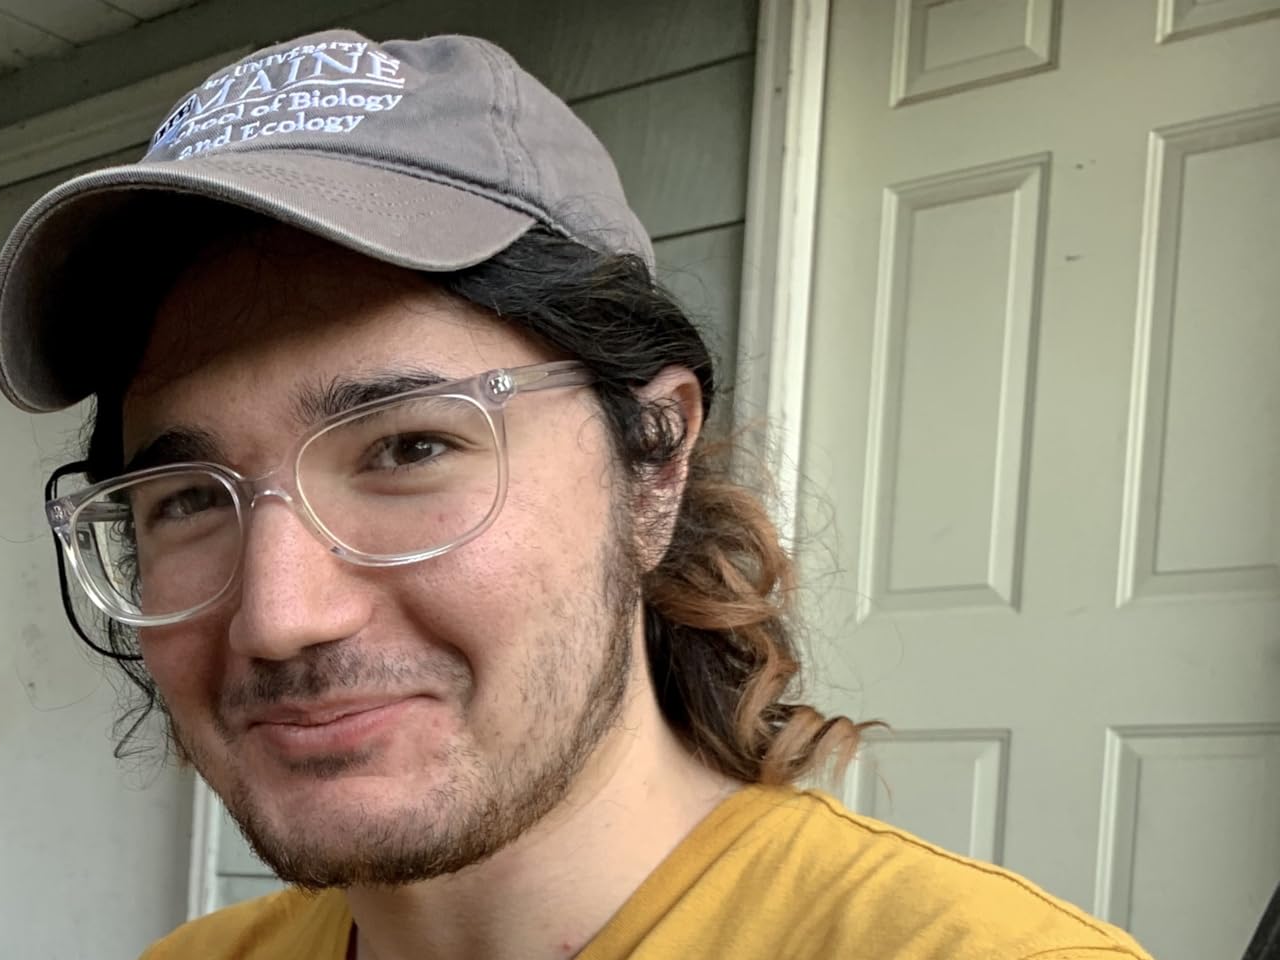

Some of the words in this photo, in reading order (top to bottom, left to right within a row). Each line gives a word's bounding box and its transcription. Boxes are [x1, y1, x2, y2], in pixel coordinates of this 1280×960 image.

[192, 50, 406, 116] MAINE
[250, 93, 287, 117] of
[287, 88, 403, 112] Biology
[178, 125, 233, 160] and
[240, 112, 365, 143] Ecology
